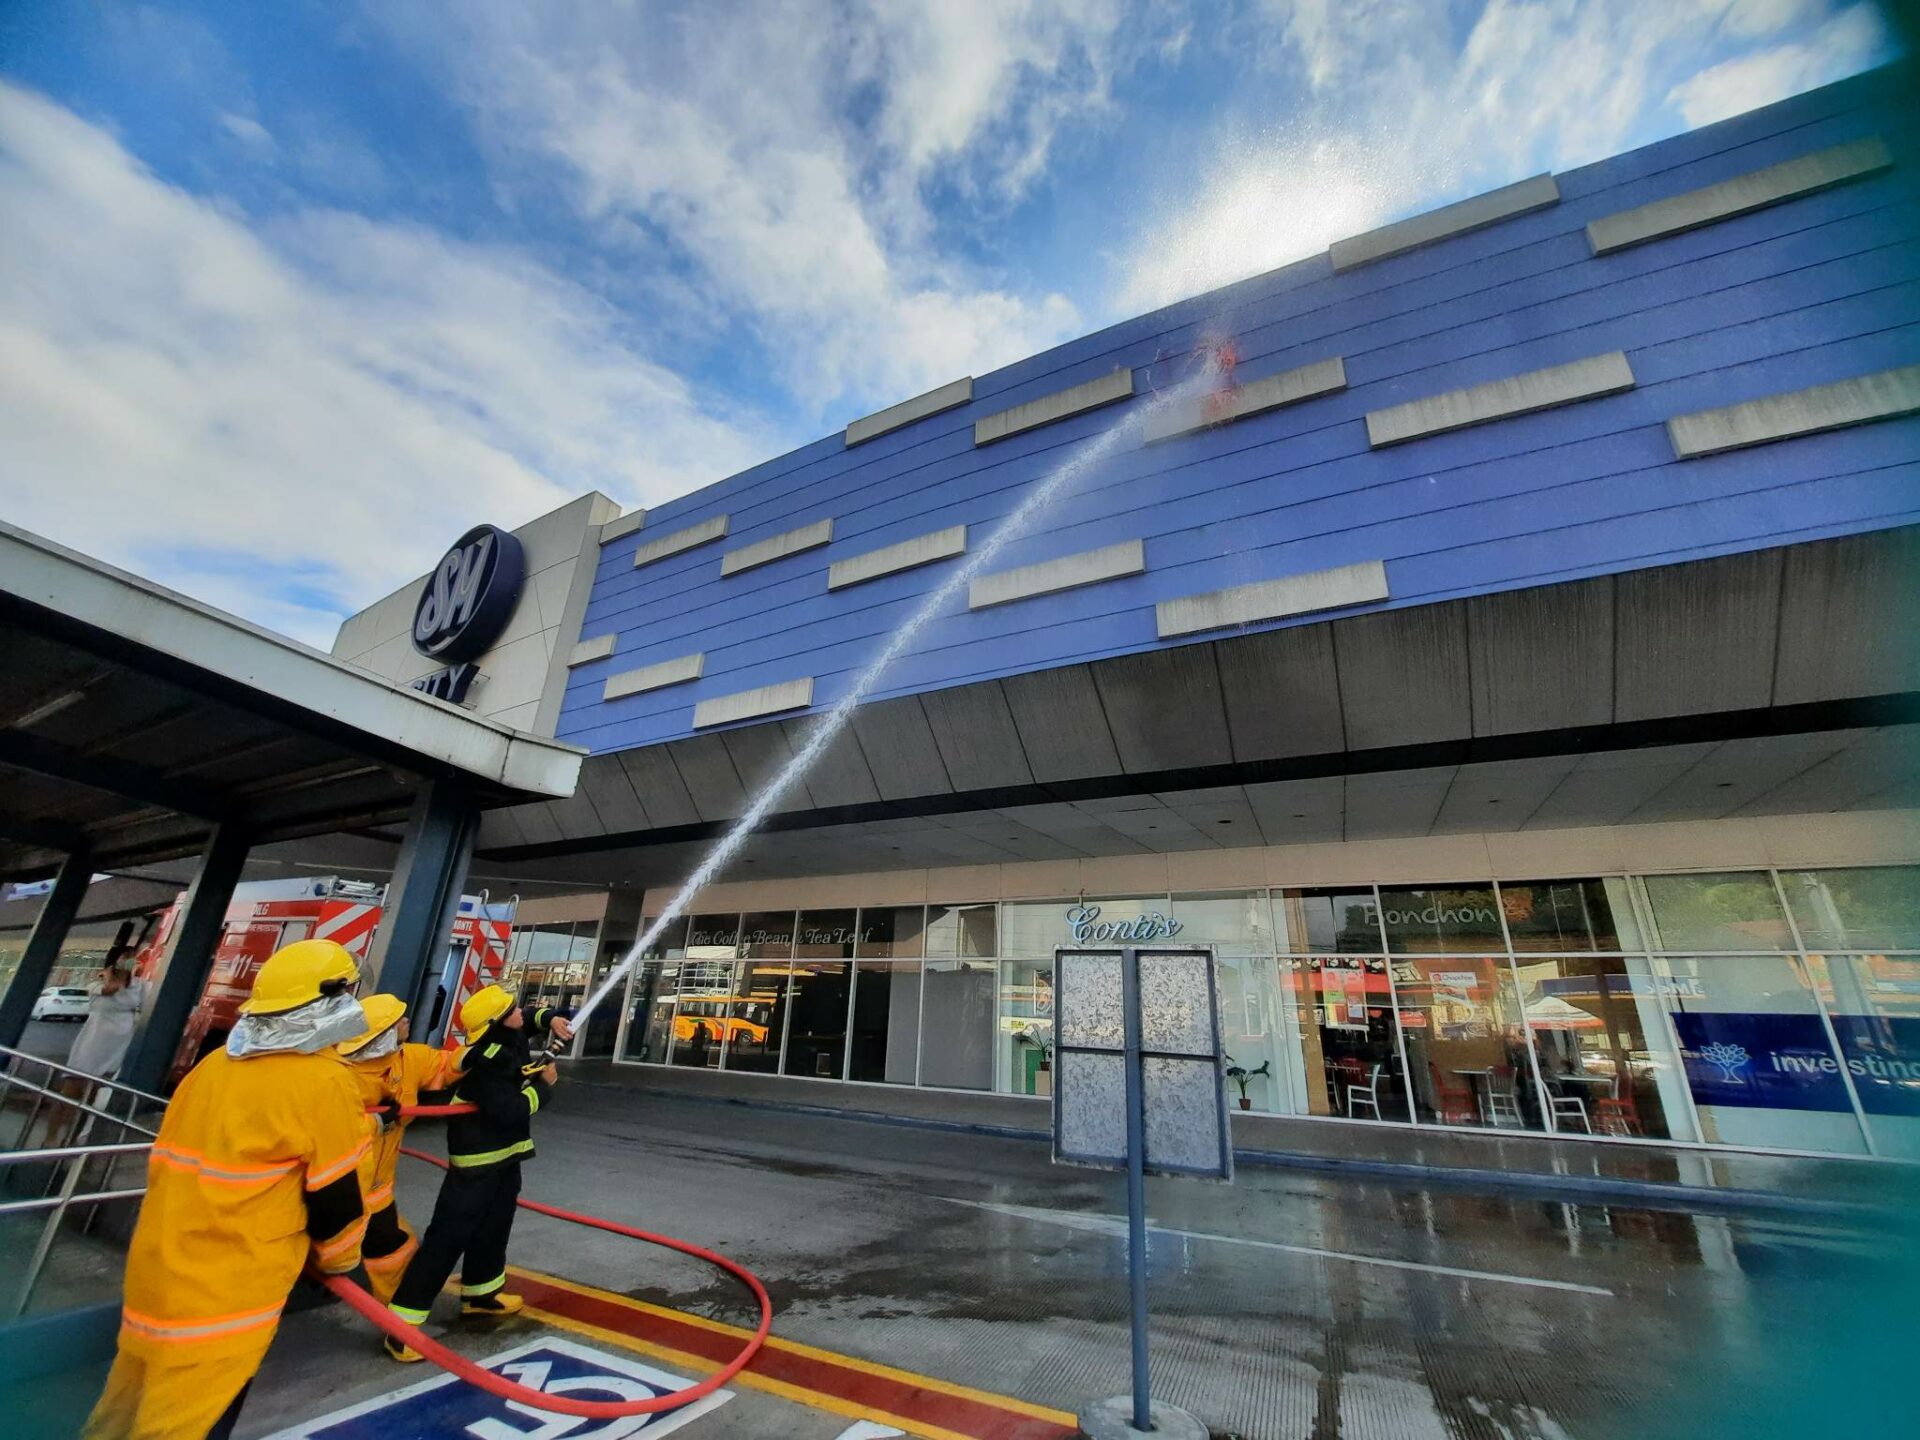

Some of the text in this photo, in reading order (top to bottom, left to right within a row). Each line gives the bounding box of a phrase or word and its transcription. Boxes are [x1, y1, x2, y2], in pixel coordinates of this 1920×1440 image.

[415, 533, 495, 641] SM
[1363, 900, 1497, 926] Bonchon
[691, 930, 711, 945] The
[713, 930, 750, 945] Coffe
[752, 929, 791, 947] Bean
[805, 928, 831, 943] Tea
